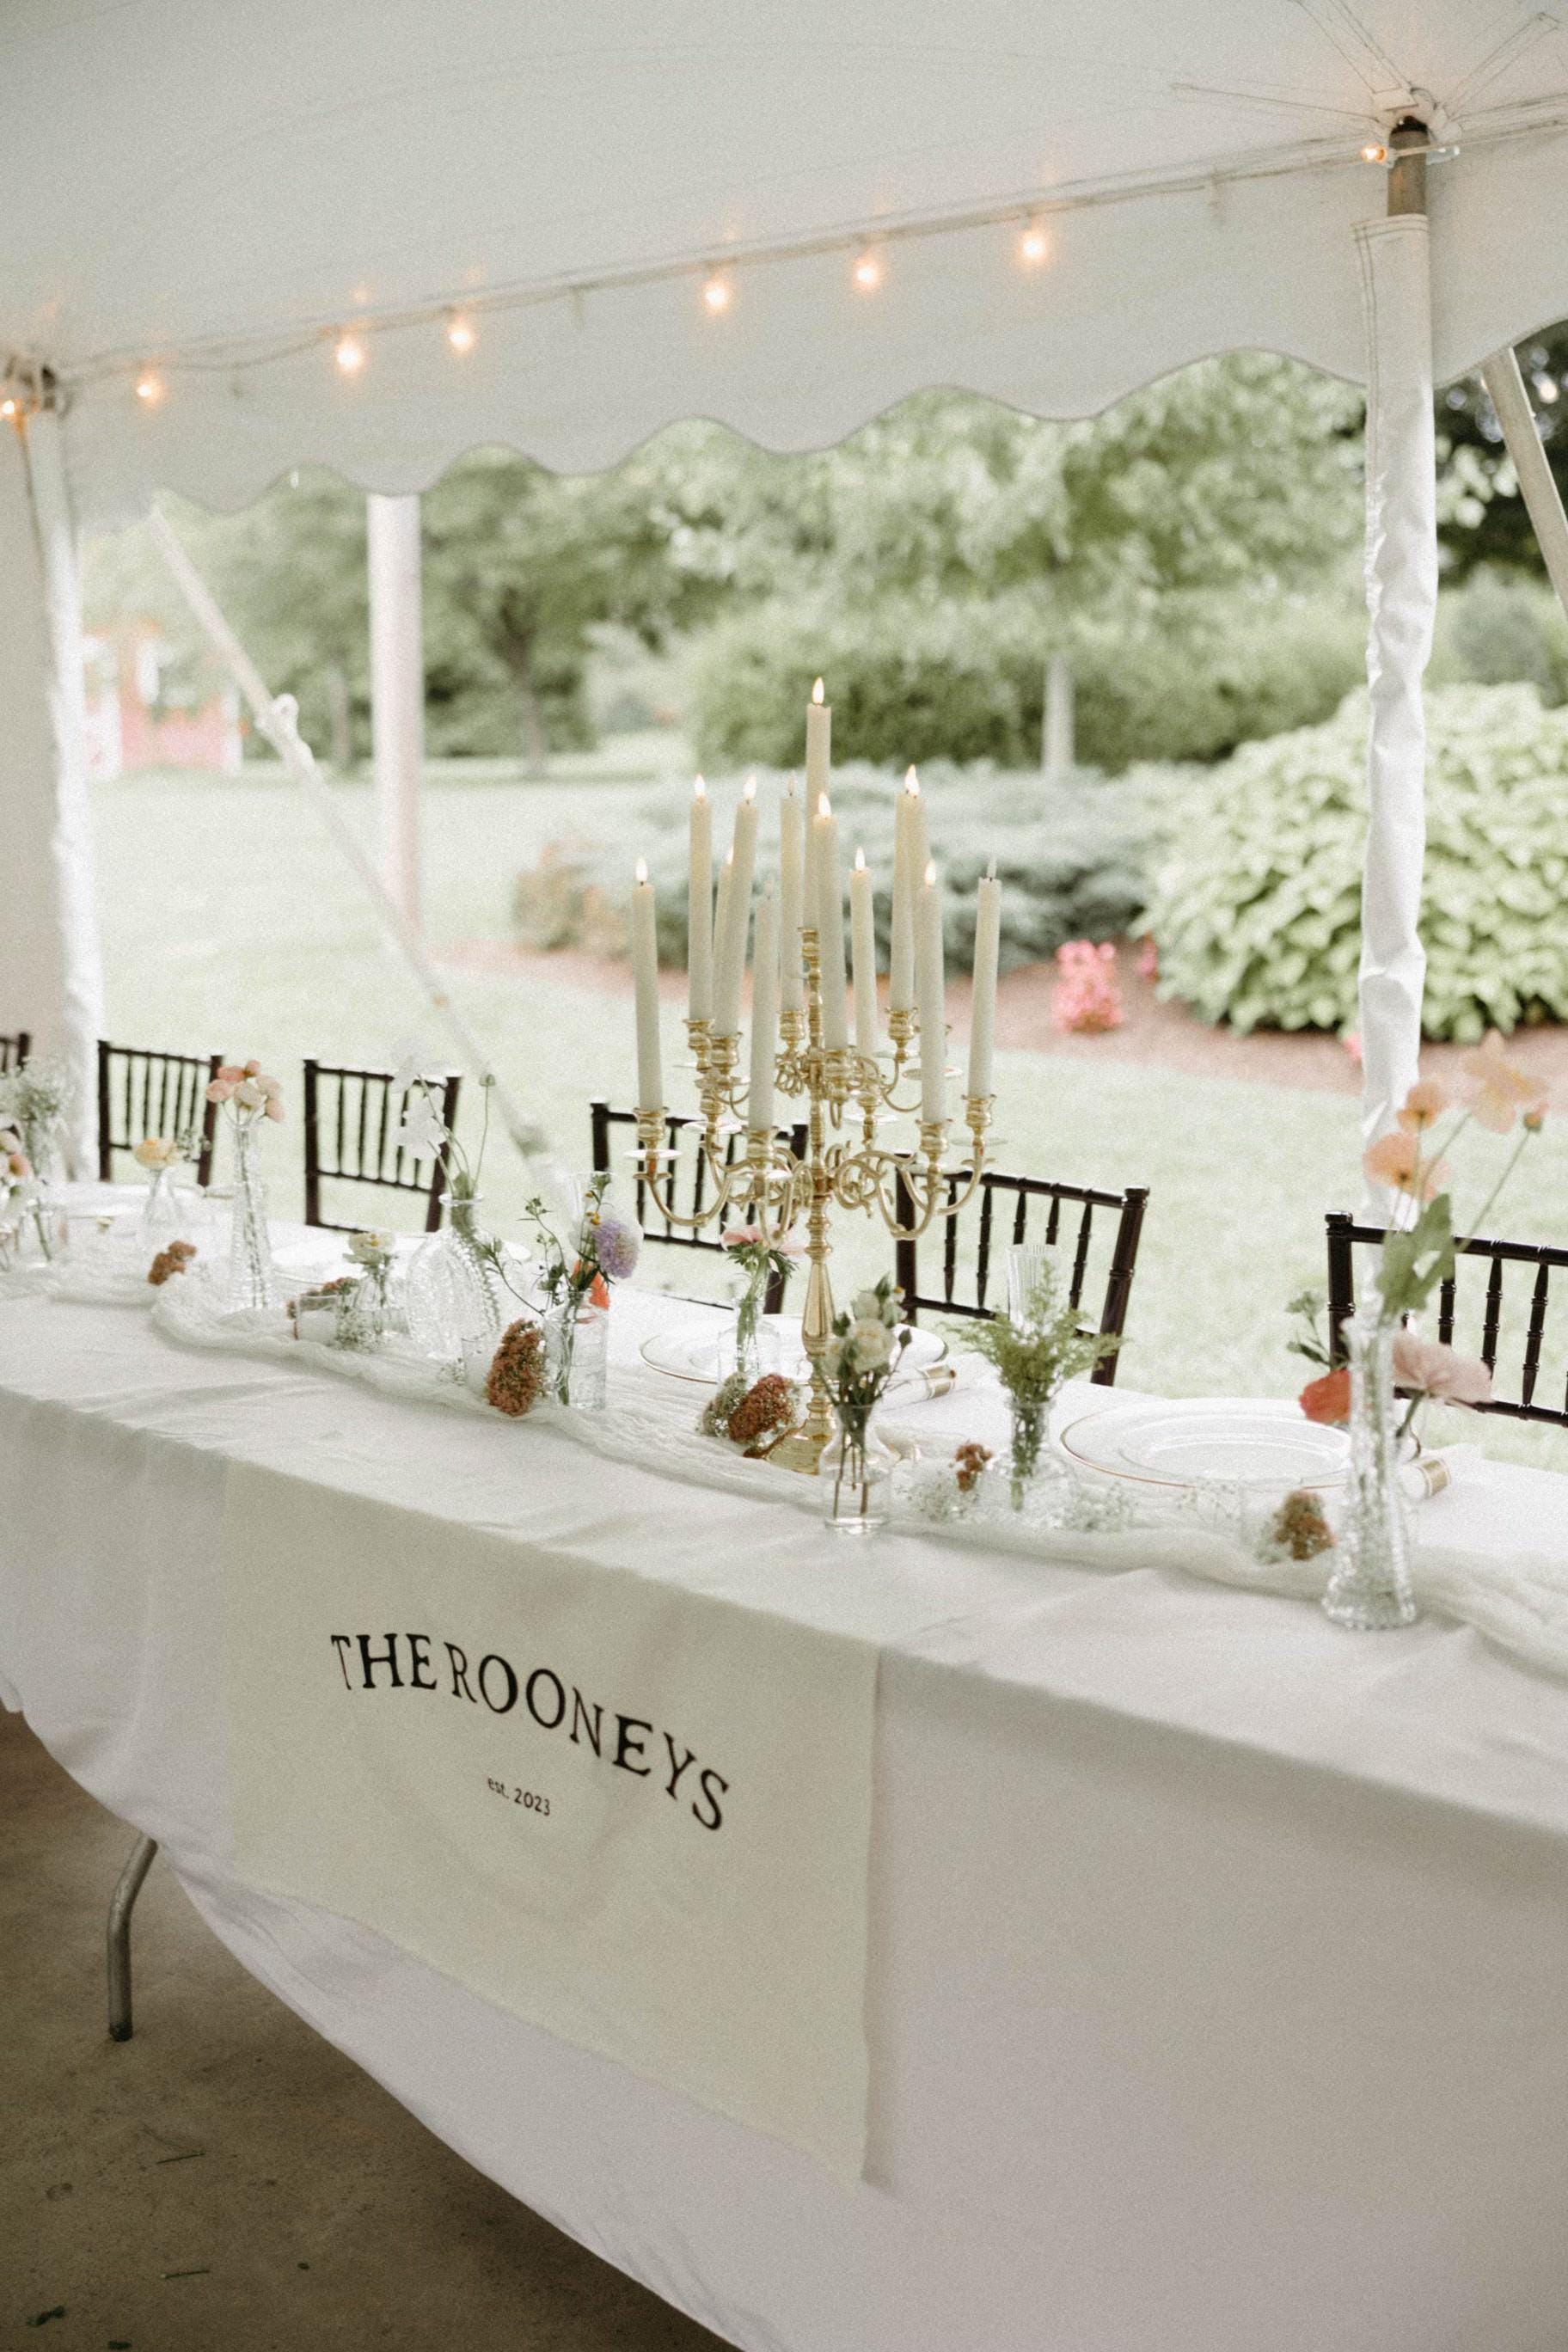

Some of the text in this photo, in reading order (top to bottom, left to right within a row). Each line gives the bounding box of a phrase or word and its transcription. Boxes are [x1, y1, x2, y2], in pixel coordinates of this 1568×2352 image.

[330, 1633, 730, 1831] THE ROONEYS
[487, 1777, 551, 1816] est. 2023
